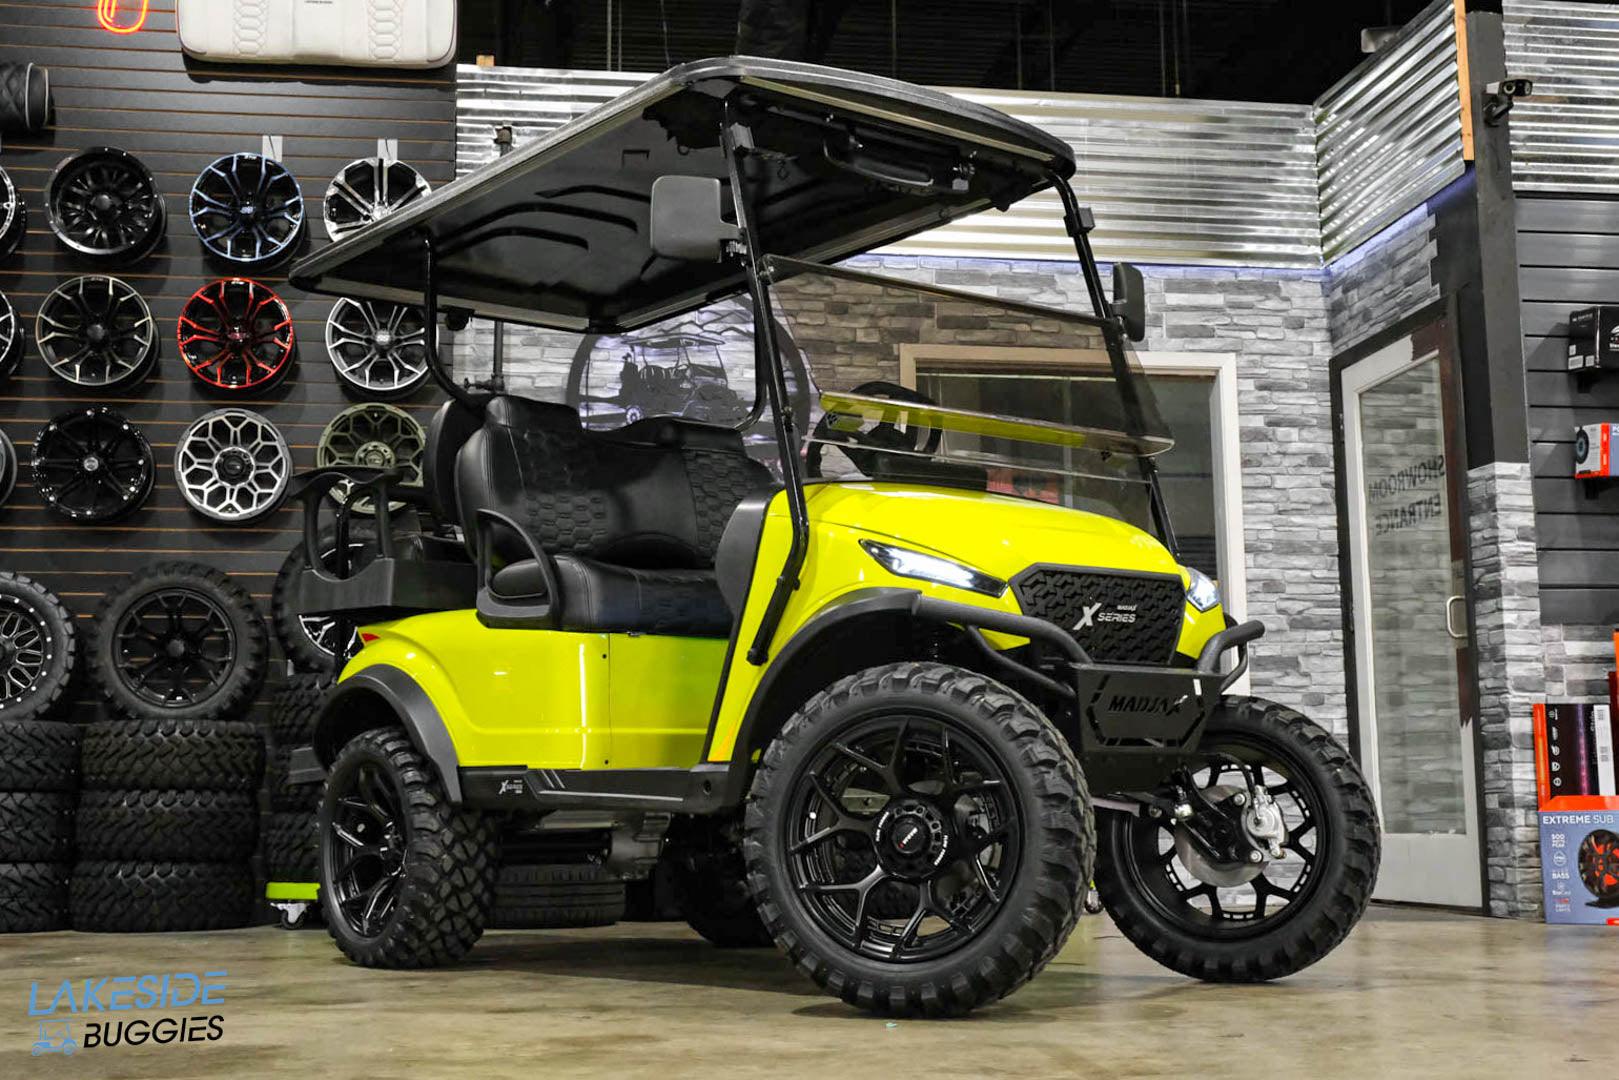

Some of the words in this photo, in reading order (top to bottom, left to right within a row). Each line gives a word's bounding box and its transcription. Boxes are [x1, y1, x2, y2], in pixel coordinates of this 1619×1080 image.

[1072, 602, 1102, 630] X
[1097, 612, 1137, 623] SERIES
[1108, 695, 1188, 716] MADJAX
[1542, 815, 1591, 825] EXTREME
